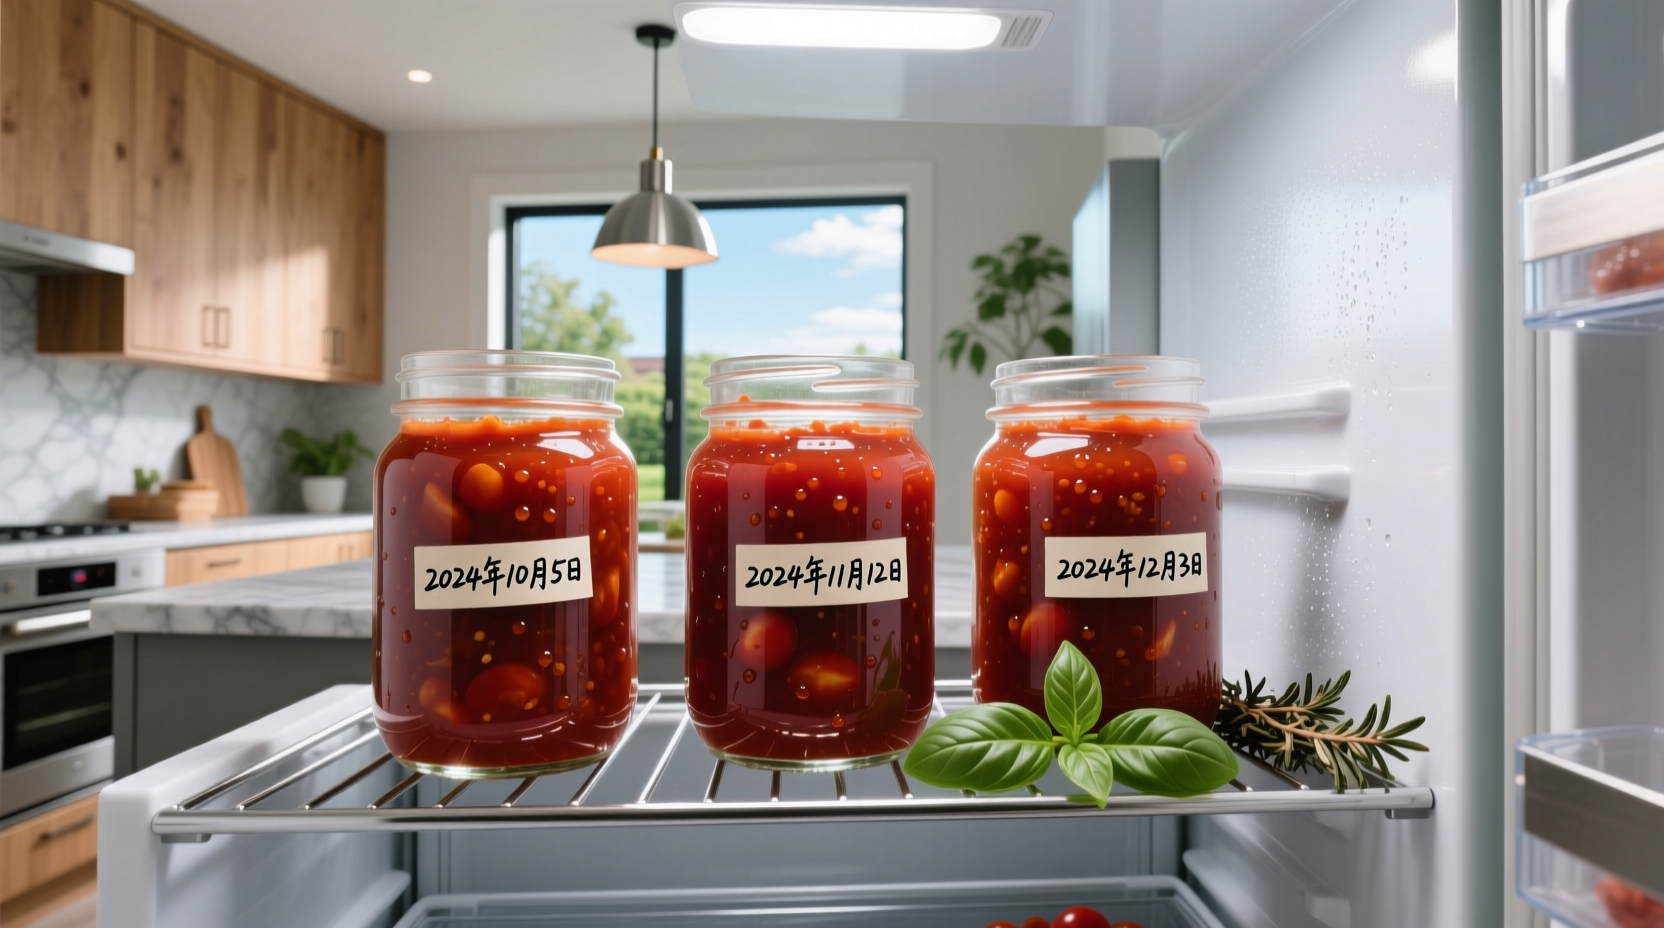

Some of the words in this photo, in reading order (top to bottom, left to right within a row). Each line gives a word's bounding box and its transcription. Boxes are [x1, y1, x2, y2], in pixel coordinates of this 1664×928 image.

[424, 556, 581, 597] 2024年10月5日
[745, 555, 901, 596] 2024年11月12日
[1057, 549, 1202, 588] 2024年12月3日
